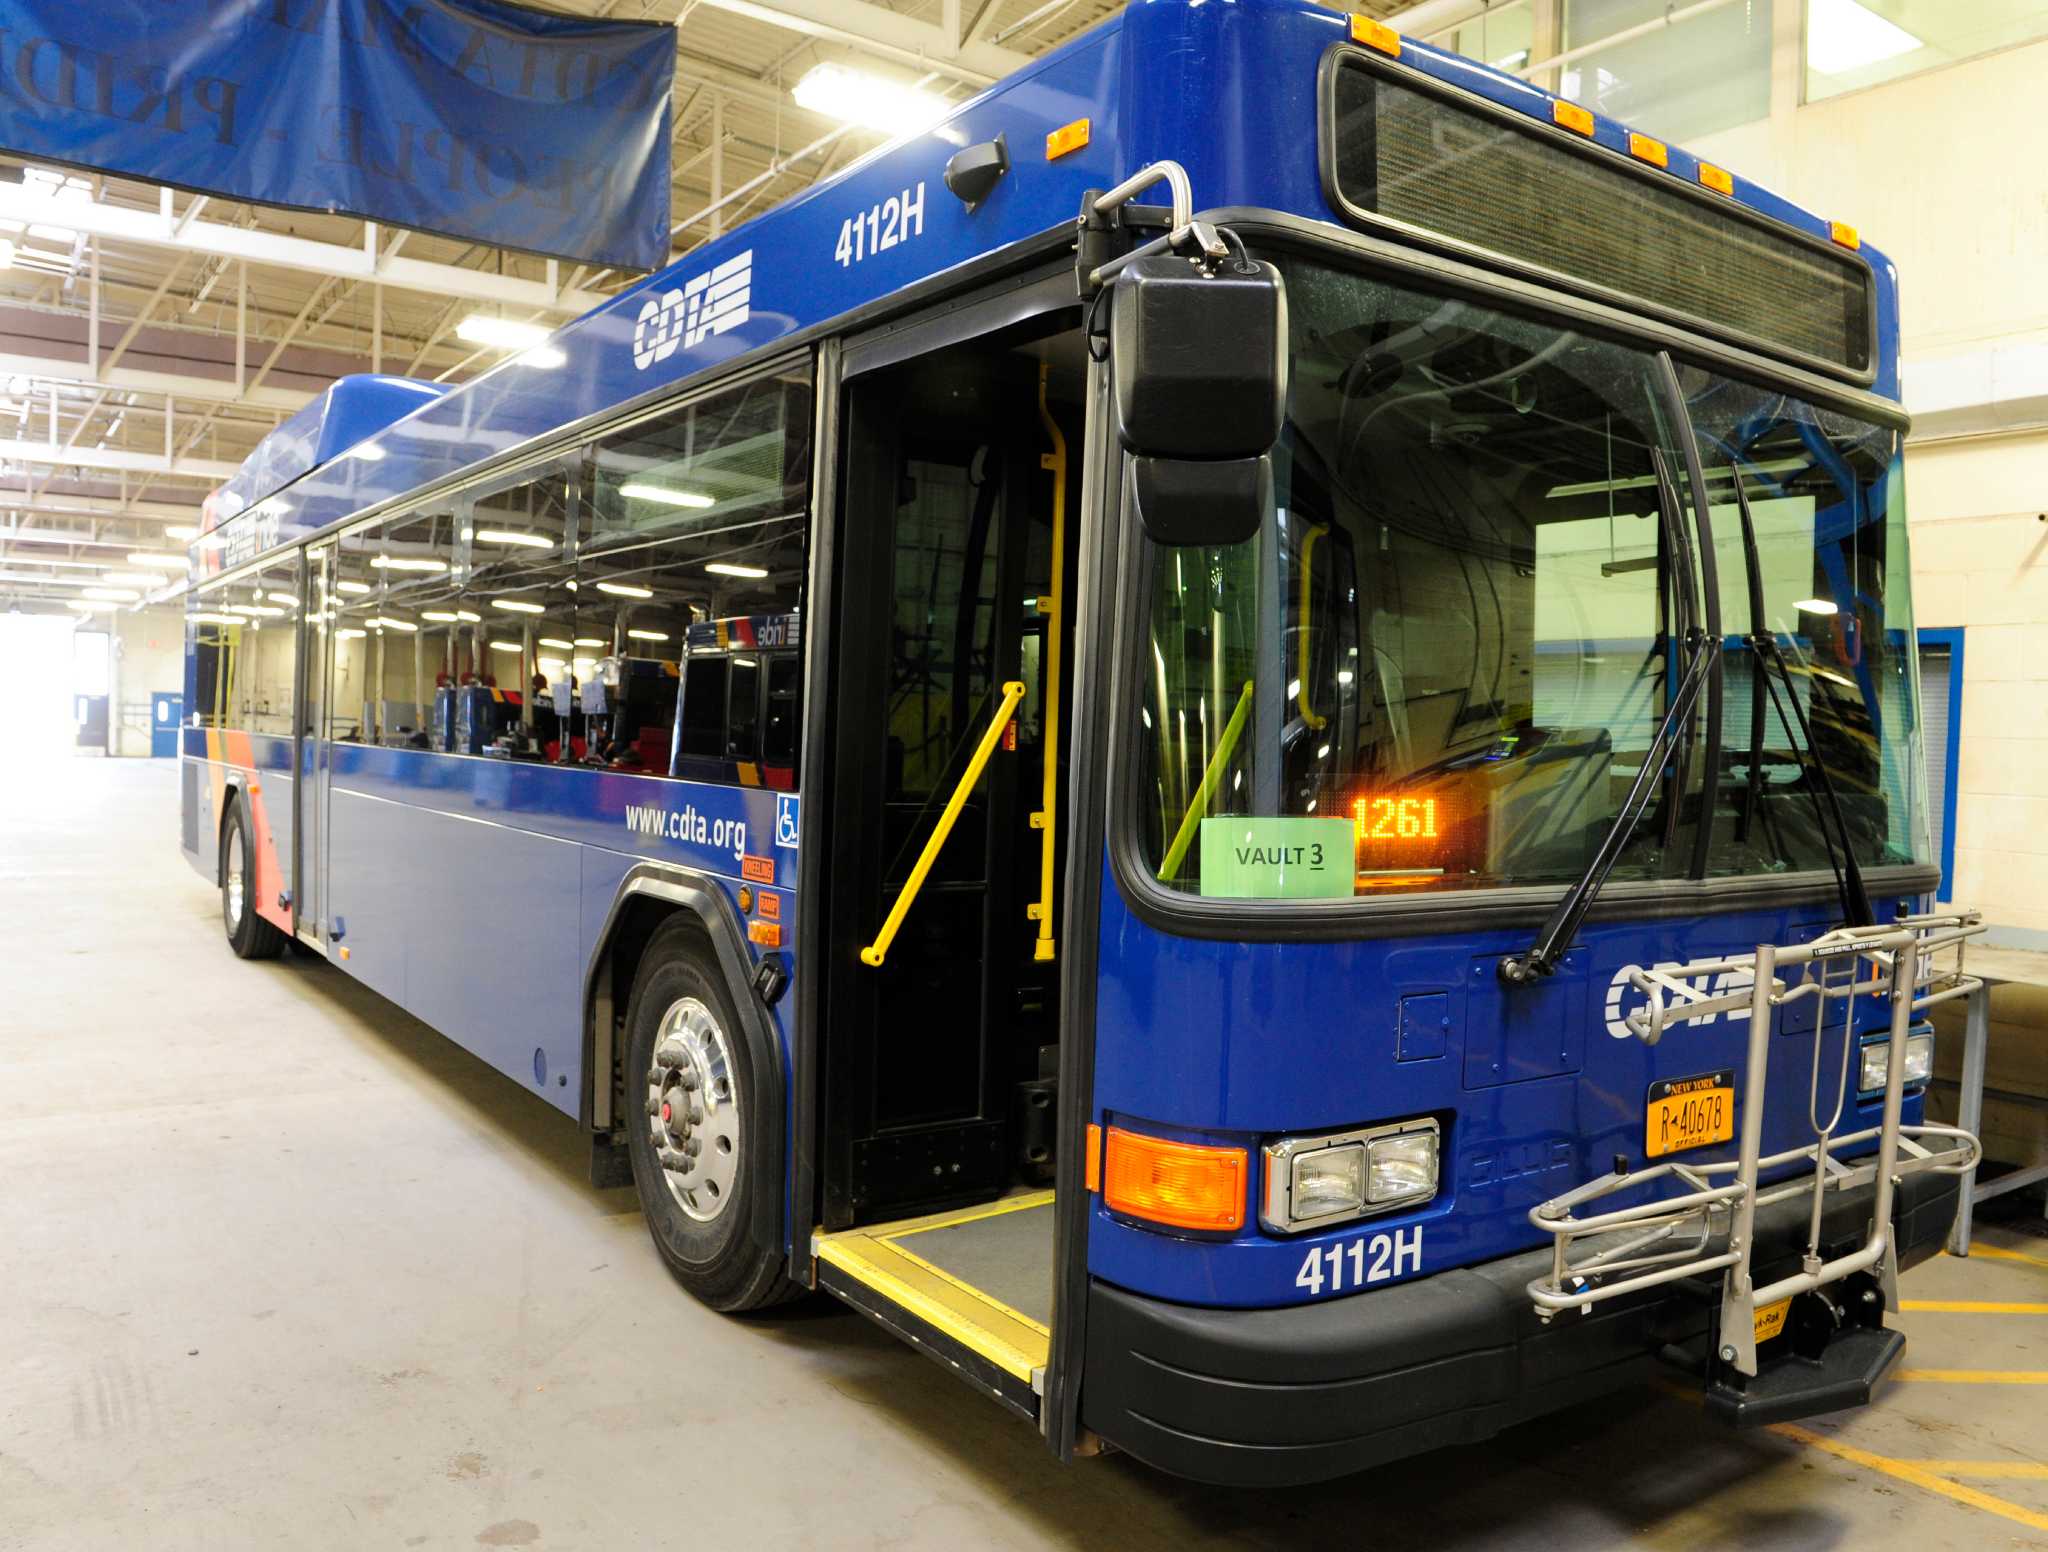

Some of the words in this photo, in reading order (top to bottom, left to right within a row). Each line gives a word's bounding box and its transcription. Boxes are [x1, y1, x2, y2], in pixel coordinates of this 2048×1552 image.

[834, 182, 926, 268] 4112H
[633, 249, 753, 371] CDTA
[626, 804, 747, 861] www.cdta.org
[1353, 798, 1437, 838] 1261
[1236, 847, 1305, 866] VAULT
[1310, 843, 1325, 866] 3
[1670, 1081, 1694, 1096] NEW
[1694, 1077, 1715, 1091] YORK
[1295, 1225, 1423, 1295] 4112H
